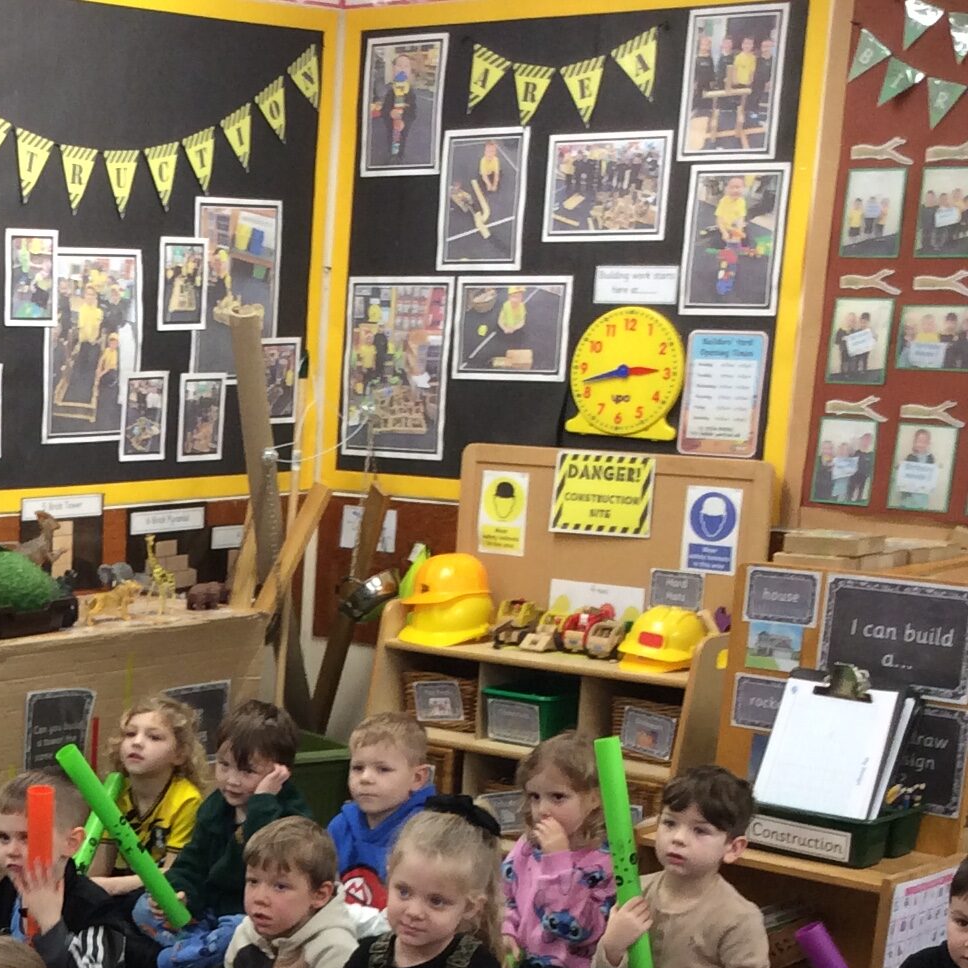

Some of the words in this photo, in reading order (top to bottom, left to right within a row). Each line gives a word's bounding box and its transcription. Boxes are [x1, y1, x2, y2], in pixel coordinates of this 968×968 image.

[474, 53, 651, 103] AREA
[606, 325, 617, 337] 11
[624, 319, 637, 331] 12
[647, 324, 653, 336] 1
[590, 341, 603, 353] 10
[659, 342, 667, 355] 2
[580, 363, 589, 373] 9
[663, 368, 671, 380] 3
[583, 387, 591, 398] 8
[652, 391, 660, 402] 4
[597, 403, 605, 415] 7
[635, 407, 643, 419] 5
[614, 413, 622, 424] 6
[568, 464, 641, 482] DANGER!
[564, 492, 640, 505] CONSTRUCTION
[589, 509, 610, 518] SITE
[762, 588, 800, 603] house
[850, 618, 858, 635] I
[863, 623, 897, 640] can
[904, 622, 954, 647] build
[751, 821, 842, 854] Construction
